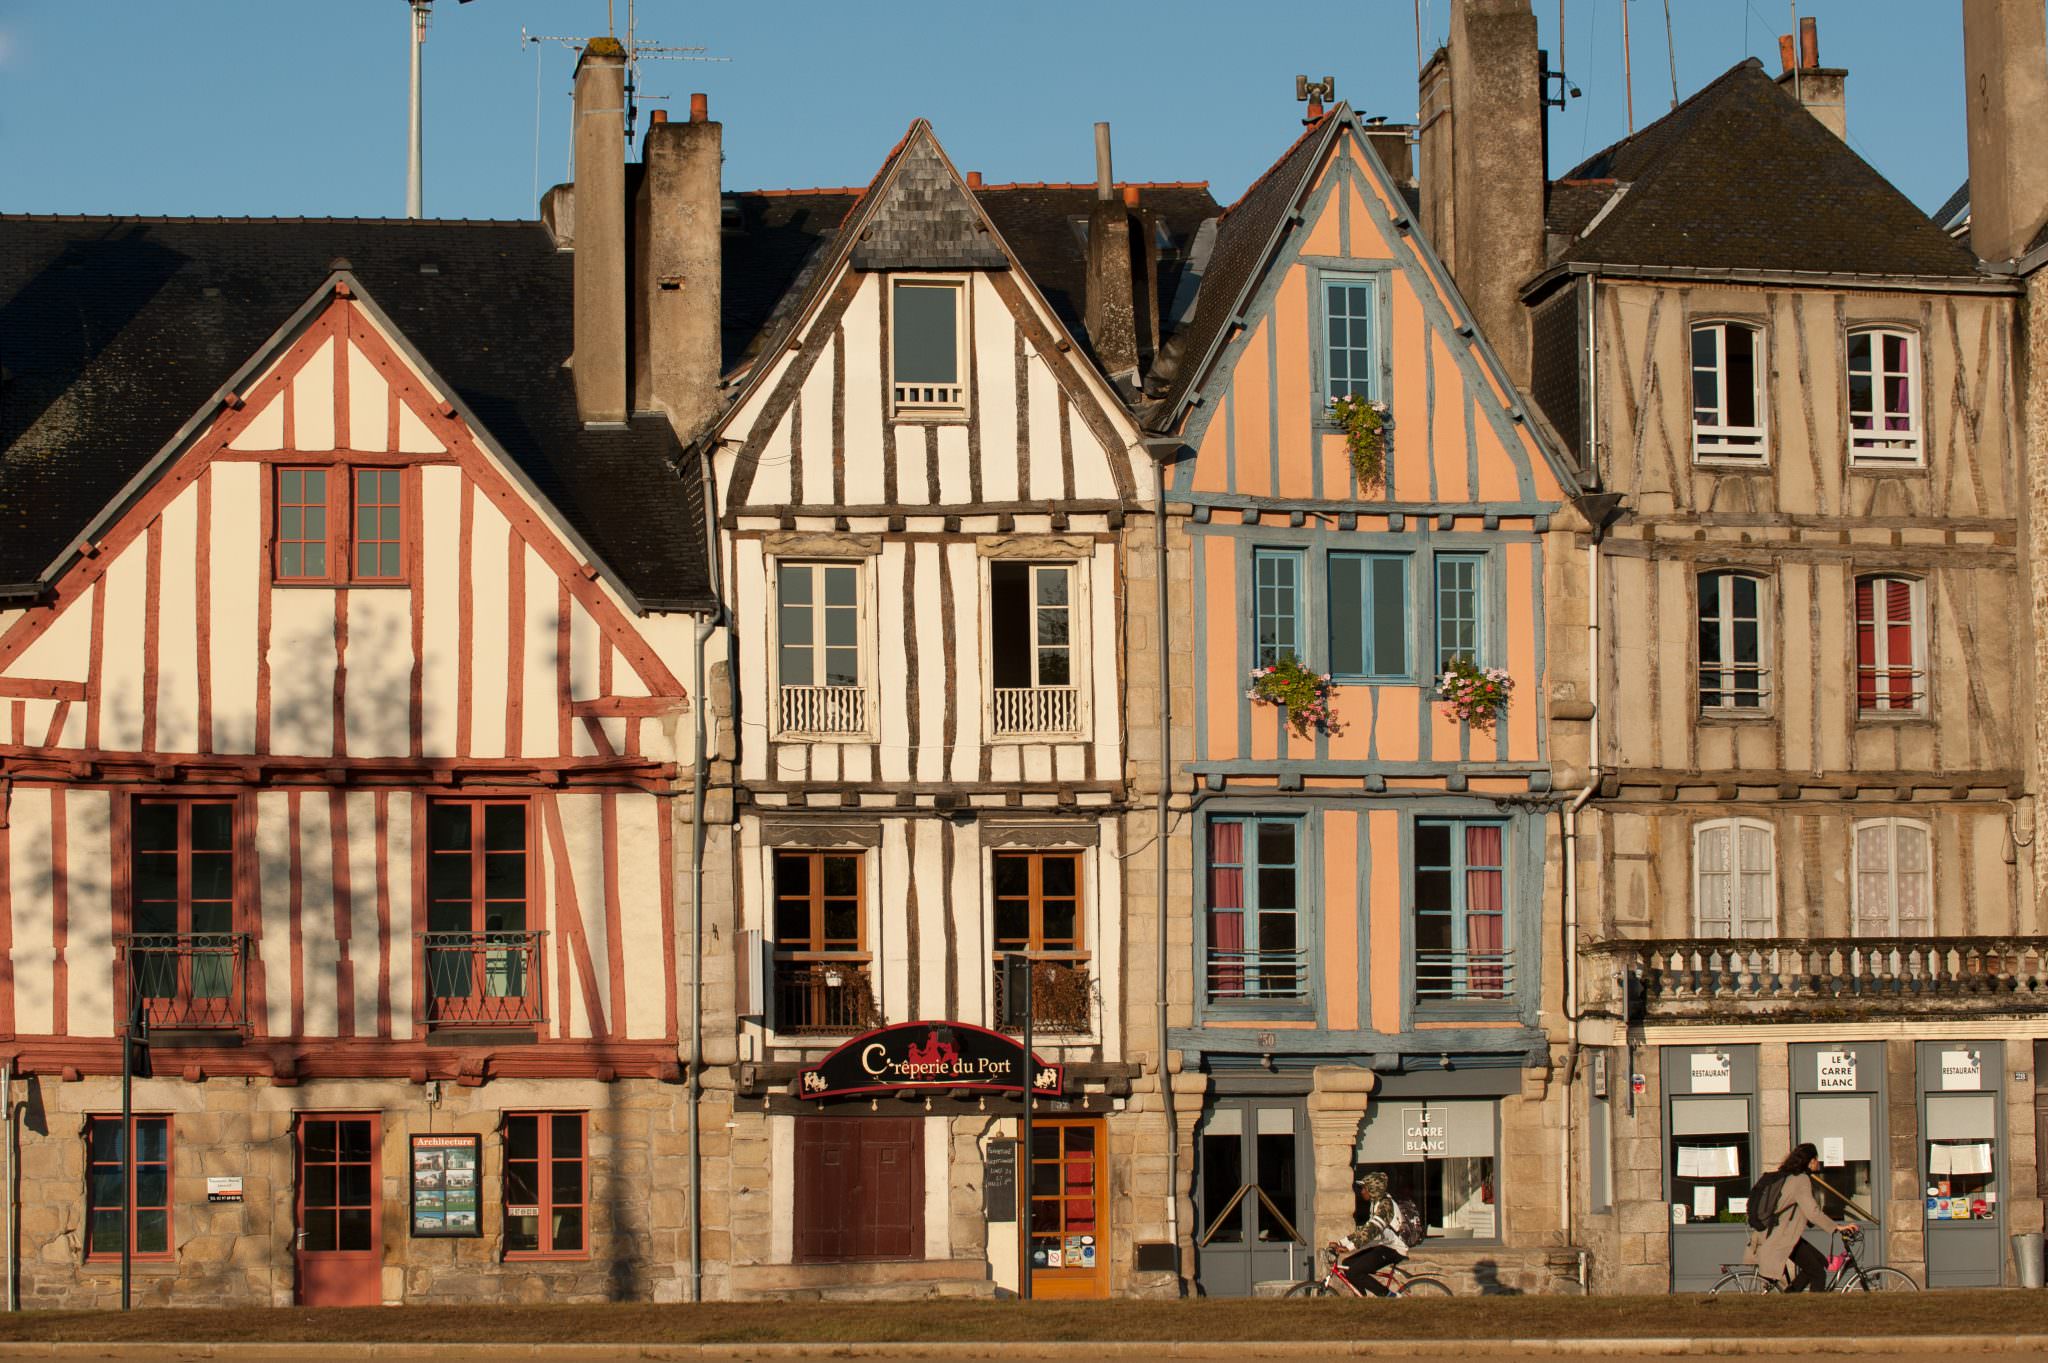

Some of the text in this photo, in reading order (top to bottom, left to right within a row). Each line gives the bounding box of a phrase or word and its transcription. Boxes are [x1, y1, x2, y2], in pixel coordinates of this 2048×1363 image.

[862, 1043, 1011, 1080] Crêperie du Port
[1832, 1056, 1841, 1064] LE
[1692, 1069, 1729, 1077] RESTAURANT
[1821, 1067, 1852, 1075] CARRE
[1943, 1067, 1979, 1075] RESTAURANT
[1821, 1079, 1853, 1087] BLANC
[1420, 1113, 1431, 1123] LE
[1407, 1127, 1443, 1137] CARRE
[417, 1137, 472, 1146] Architecture
[1406, 1141, 1444, 1151] BLANC
